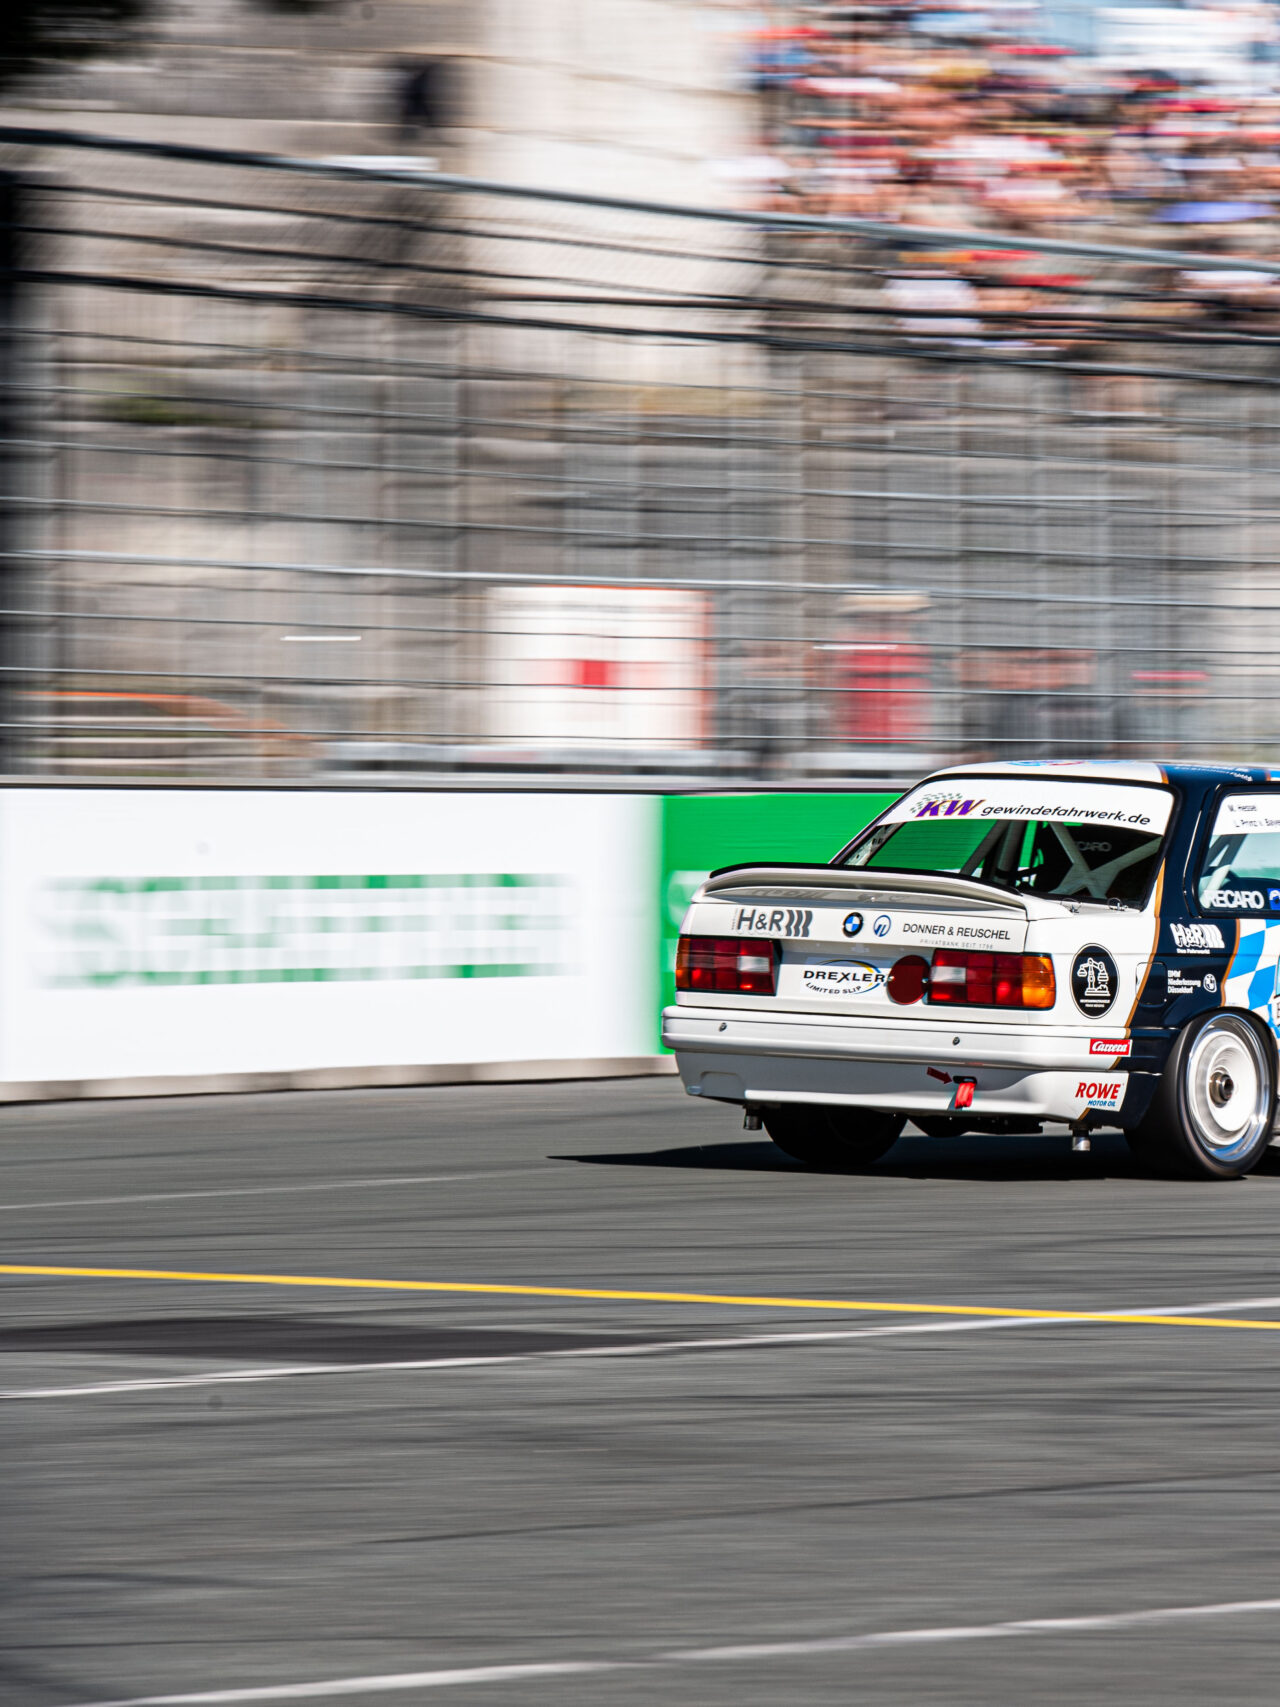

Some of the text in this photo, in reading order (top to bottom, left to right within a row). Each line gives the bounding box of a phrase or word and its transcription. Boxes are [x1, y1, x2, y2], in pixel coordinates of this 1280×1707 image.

[915, 799, 1151, 826] KW gewindefahrwerk.de
[1203, 888, 1265, 910] RECARO
[903, 923, 1011, 941] DONNER & REUSCHEL
[920, 938, 959, 948] PRIVATBANK
[961, 941, 977, 949] SEIT
[803, 970, 886, 983] DREXLER
[806, 982, 861, 995] LIMITED SLIP
[1091, 1040, 1128, 1052] Carrera
[1075, 1082, 1121, 1100] ROWE
